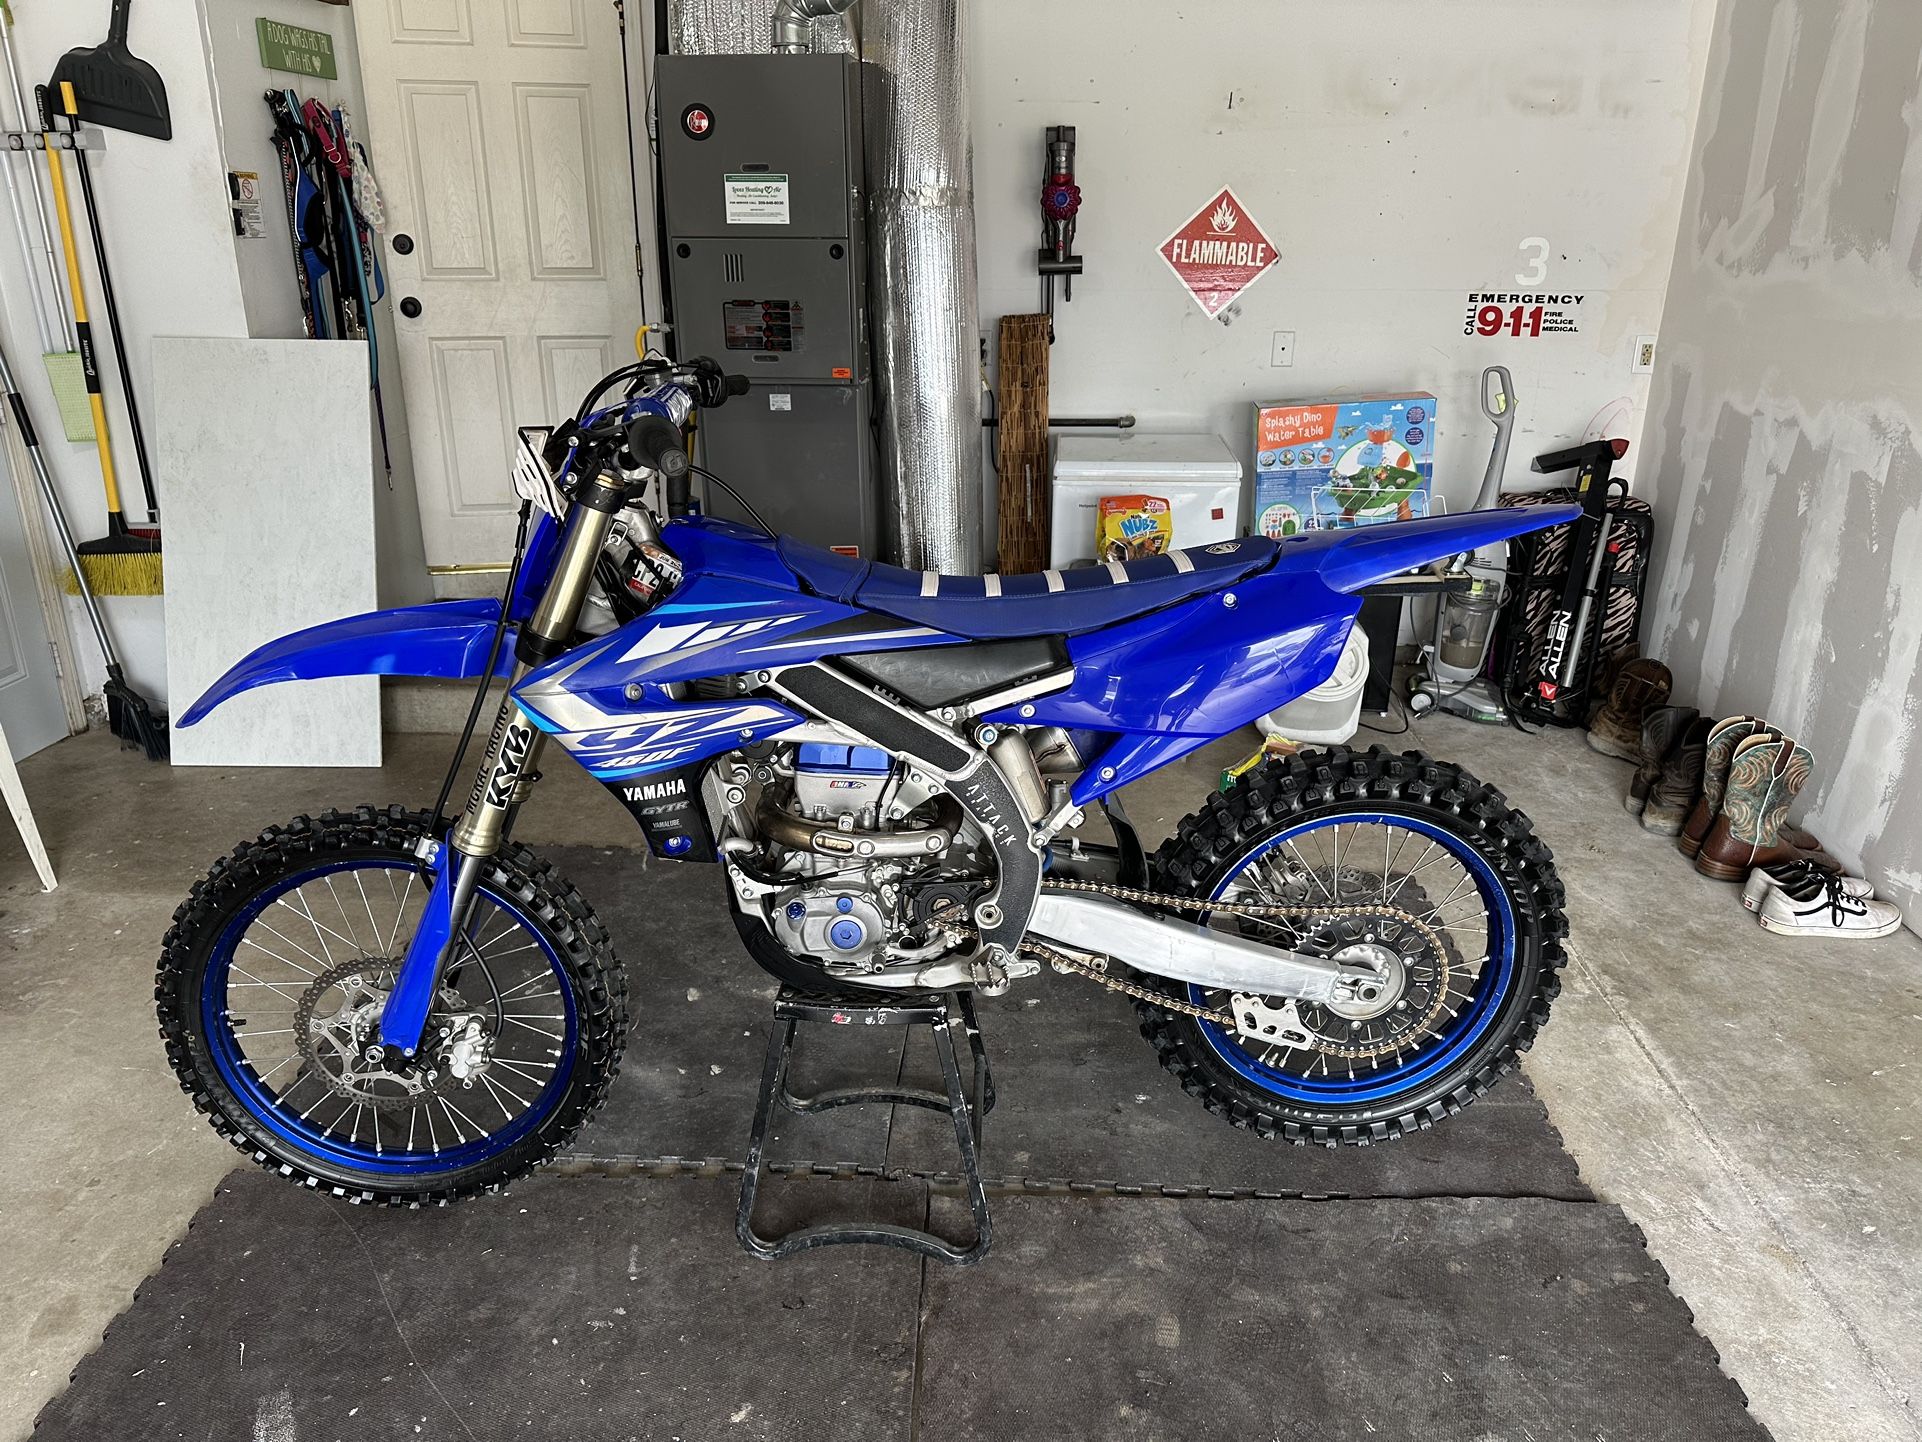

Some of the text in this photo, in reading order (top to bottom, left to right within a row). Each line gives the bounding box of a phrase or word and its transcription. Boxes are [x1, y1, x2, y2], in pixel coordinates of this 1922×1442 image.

[272, 23, 289, 45] DOG
[288, 27, 309, 49] WAGS
[308, 31, 318, 51] HIS
[282, 48, 301, 70] WITH
[1172, 239, 1266, 267] FLAMMABLE
[1515, 236, 1550, 287] 3
[1208, 292, 1219, 307] 2
[1468, 293, 1584, 305] EMERGENCY
[1464, 305, 1477, 335] CALL
[1476, 305, 1544, 337] 9-1-1
[1265, 411, 1322, 430] Splashy Dino
[1265, 425, 1324, 443] Water Table
[1120, 518, 1158, 538] NUBZ
[1539, 610, 1561, 677] ALLEN
[1548, 610, 1572, 680] ALLEN
[484, 722, 532, 810] KYB
[623, 778, 687, 801] YAMAHA
[652, 818, 680, 829] YAMALUBE
[967, 784, 1017, 847] ATTACK
